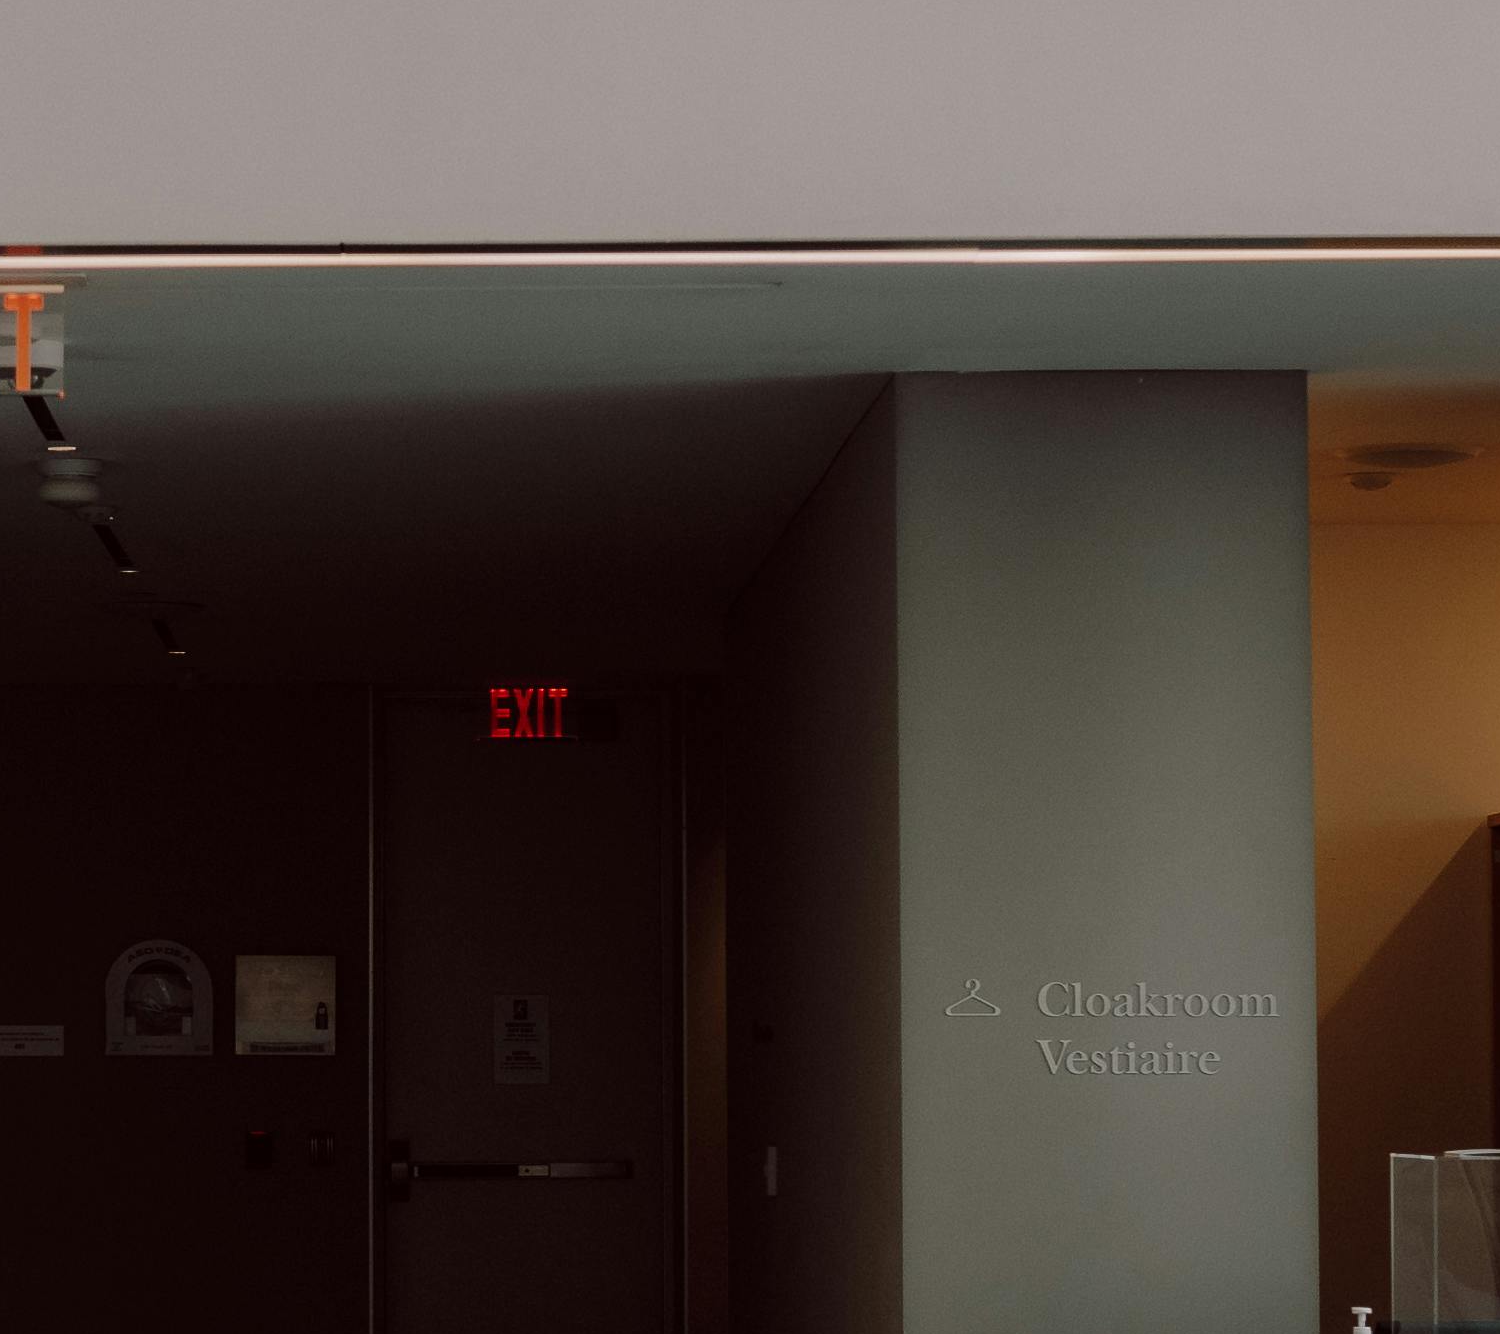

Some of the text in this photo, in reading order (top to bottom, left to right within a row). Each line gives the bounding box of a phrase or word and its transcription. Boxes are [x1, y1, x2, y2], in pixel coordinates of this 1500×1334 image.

[489, 687, 569, 738] EXIT
[1036, 981, 1281, 1017] Cloakroom
[1036, 1040, 1222, 1076] Vestiaire
